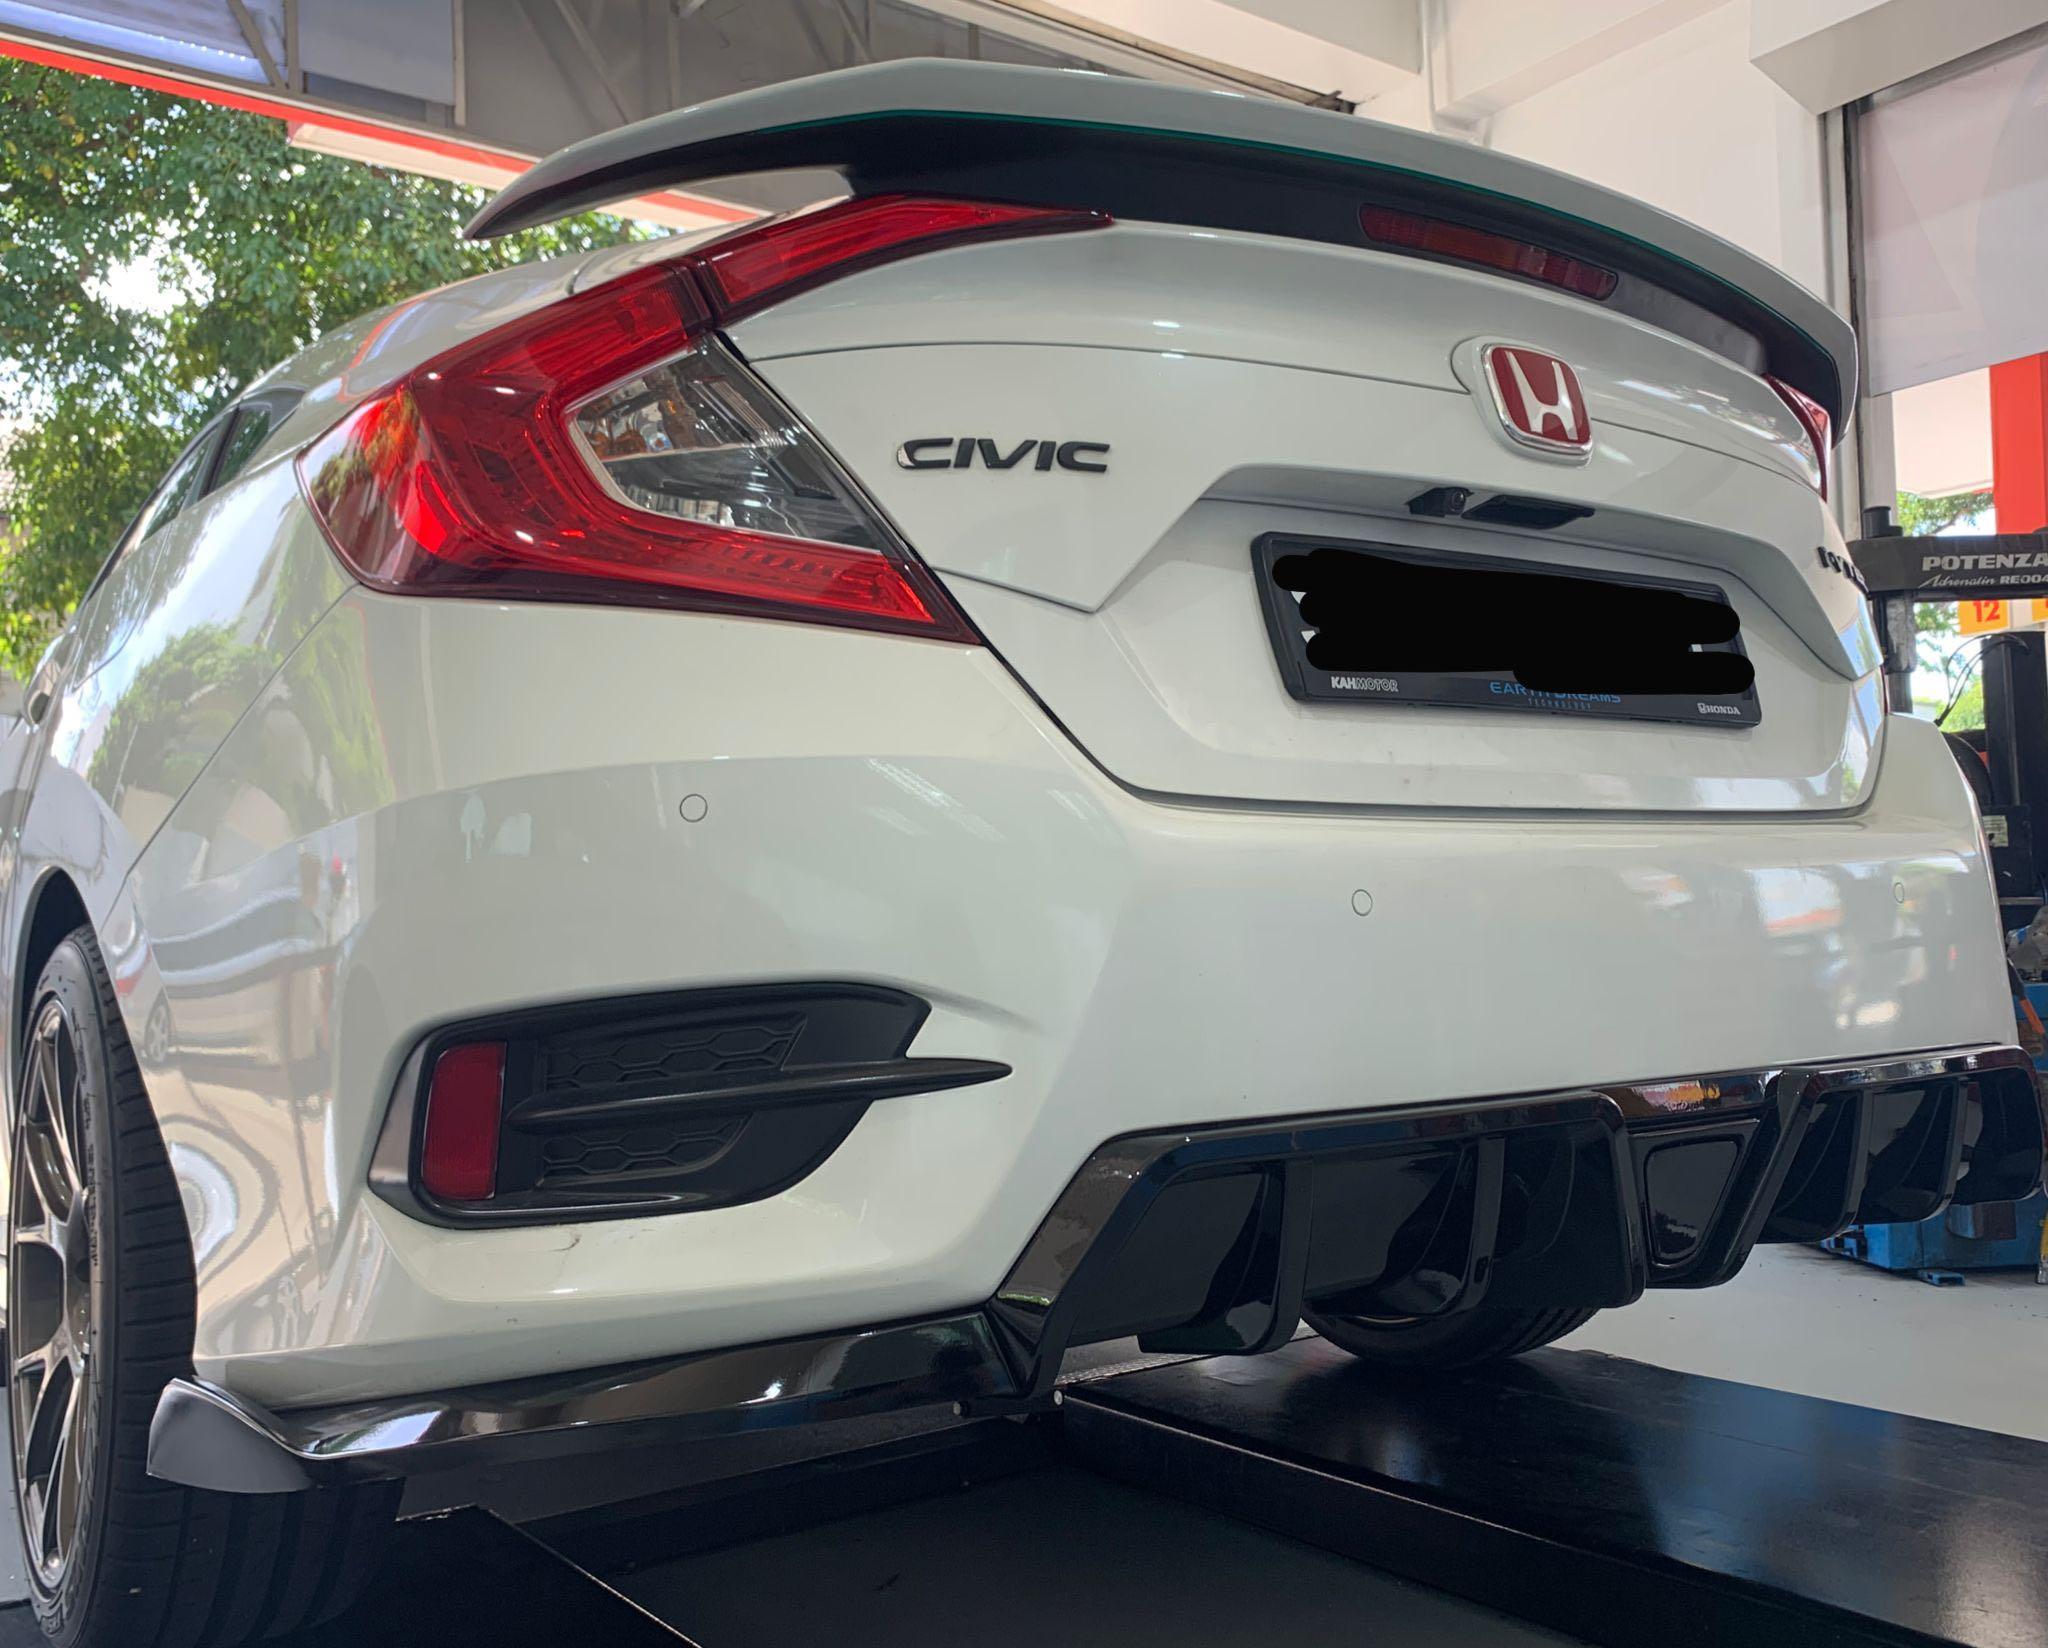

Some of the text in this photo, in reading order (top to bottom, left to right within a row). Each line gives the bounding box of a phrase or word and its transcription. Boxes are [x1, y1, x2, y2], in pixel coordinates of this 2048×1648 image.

[897, 438, 1110, 473] CIVIC
[1922, 552, 2048, 571] POTENZA
[1918, 574, 1996, 588] Adrenalin
[1973, 599, 2000, 623] 12
[1331, 676, 1399, 693] KAHMOTOR
[1705, 704, 1741, 716] HONDA
